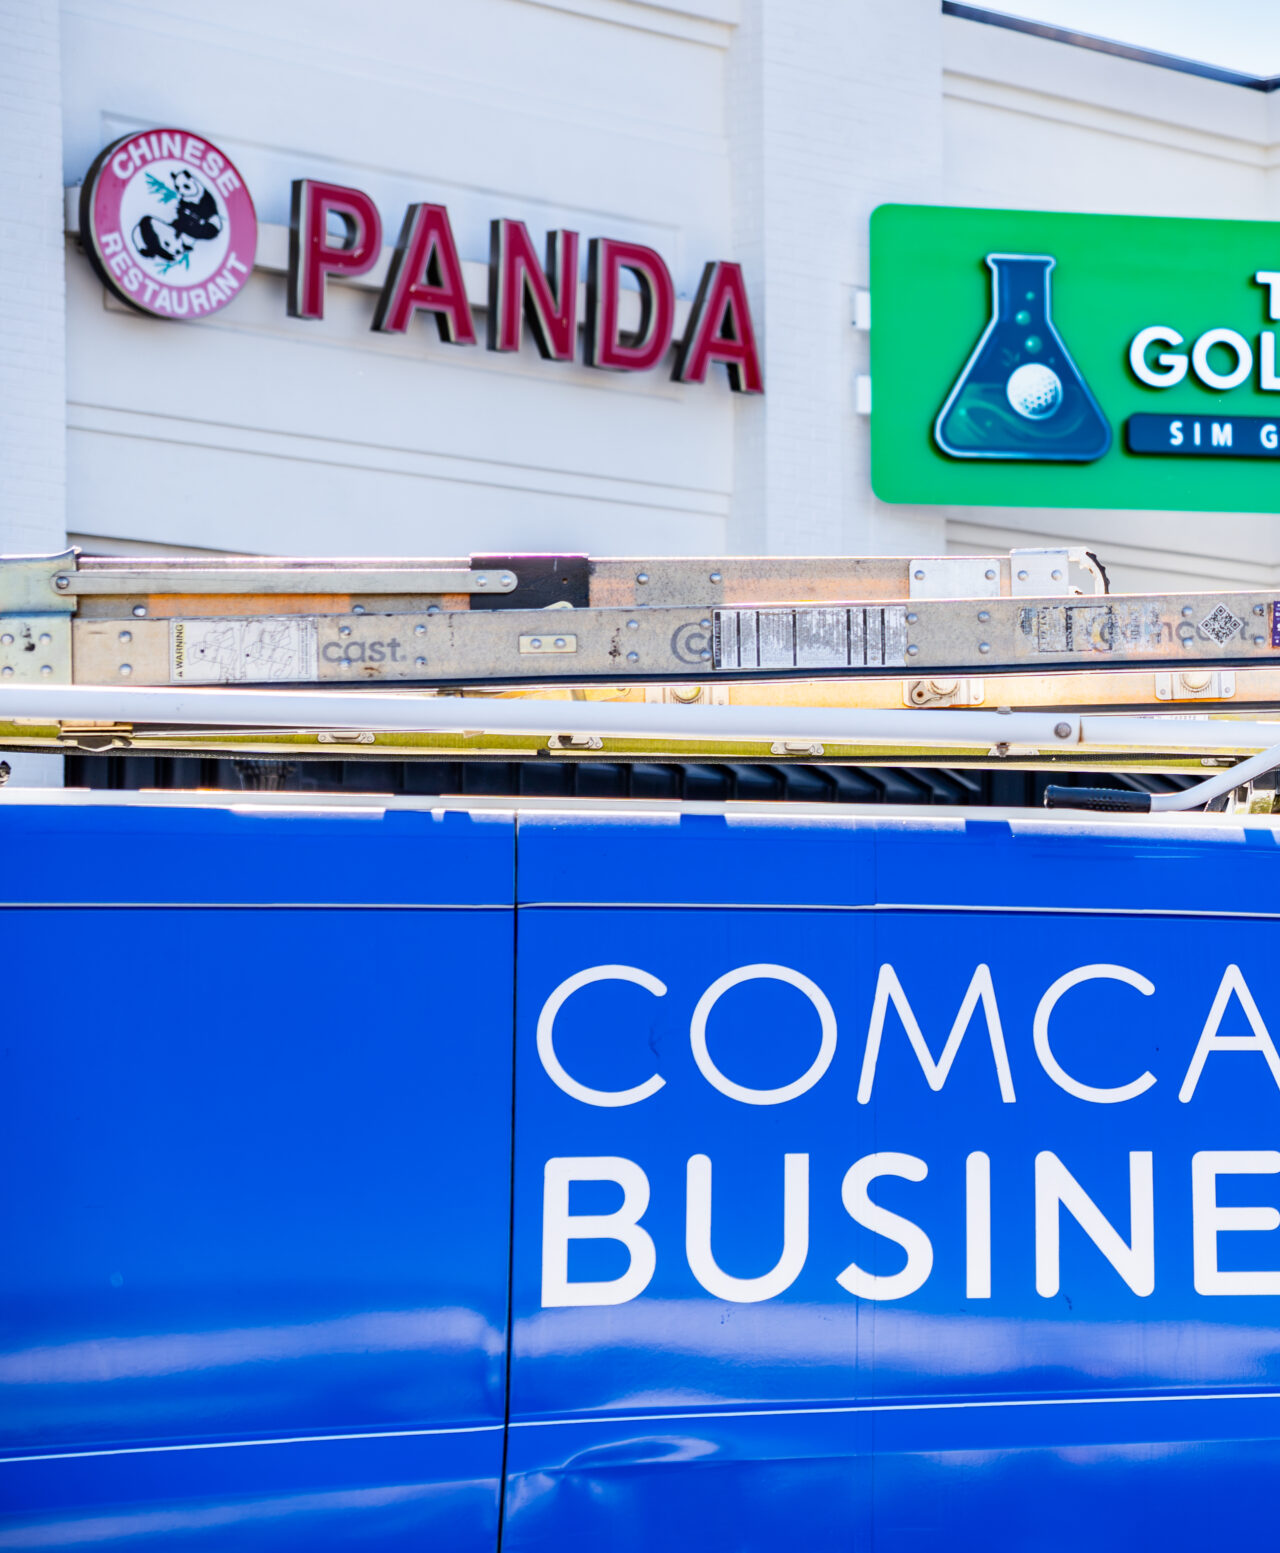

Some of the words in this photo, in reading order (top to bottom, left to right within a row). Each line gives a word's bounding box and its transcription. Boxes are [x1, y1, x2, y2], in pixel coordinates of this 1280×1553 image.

[111, 131, 241, 198] CHINESE
[101, 231, 248, 316] RESTAURANT
[287, 178, 765, 395] PANDA
[1169, 420, 1233, 447] SIM
[175, 623, 185, 669] WARNING
[321, 637, 402, 663] cast
